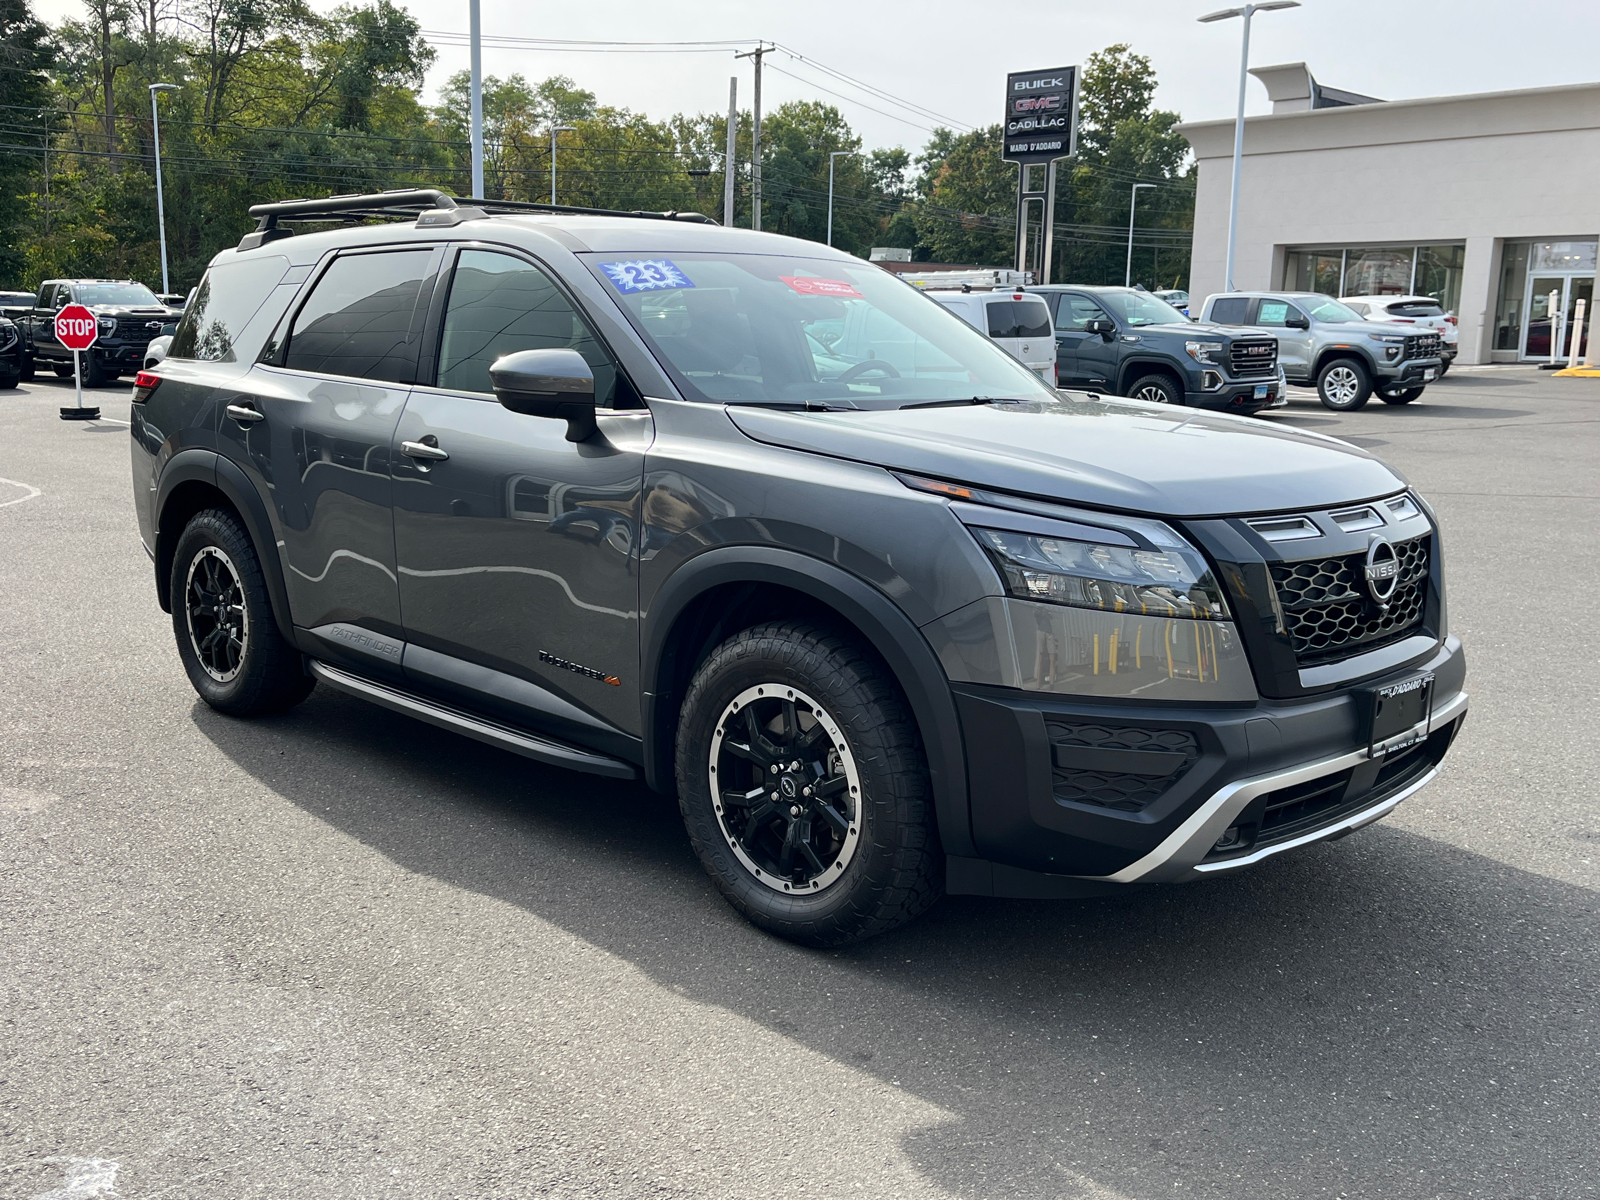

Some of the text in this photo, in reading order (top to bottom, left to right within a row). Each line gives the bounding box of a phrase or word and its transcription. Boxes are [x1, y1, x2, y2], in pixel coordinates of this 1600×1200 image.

[1014, 77, 1063, 91] BUICK
[1016, 96, 1060, 111] GMC
[1008, 118, 1065, 130] CADILLAC
[1010, 142, 1061, 152] MARIO D'ADDARIO
[623, 264, 668, 284] 23
[58, 319, 94, 336] STOP
[1366, 565, 1398, 578] NISSA
[330, 626, 401, 658] PATHFINDER
[538, 649, 607, 682] ROCK CREEK
